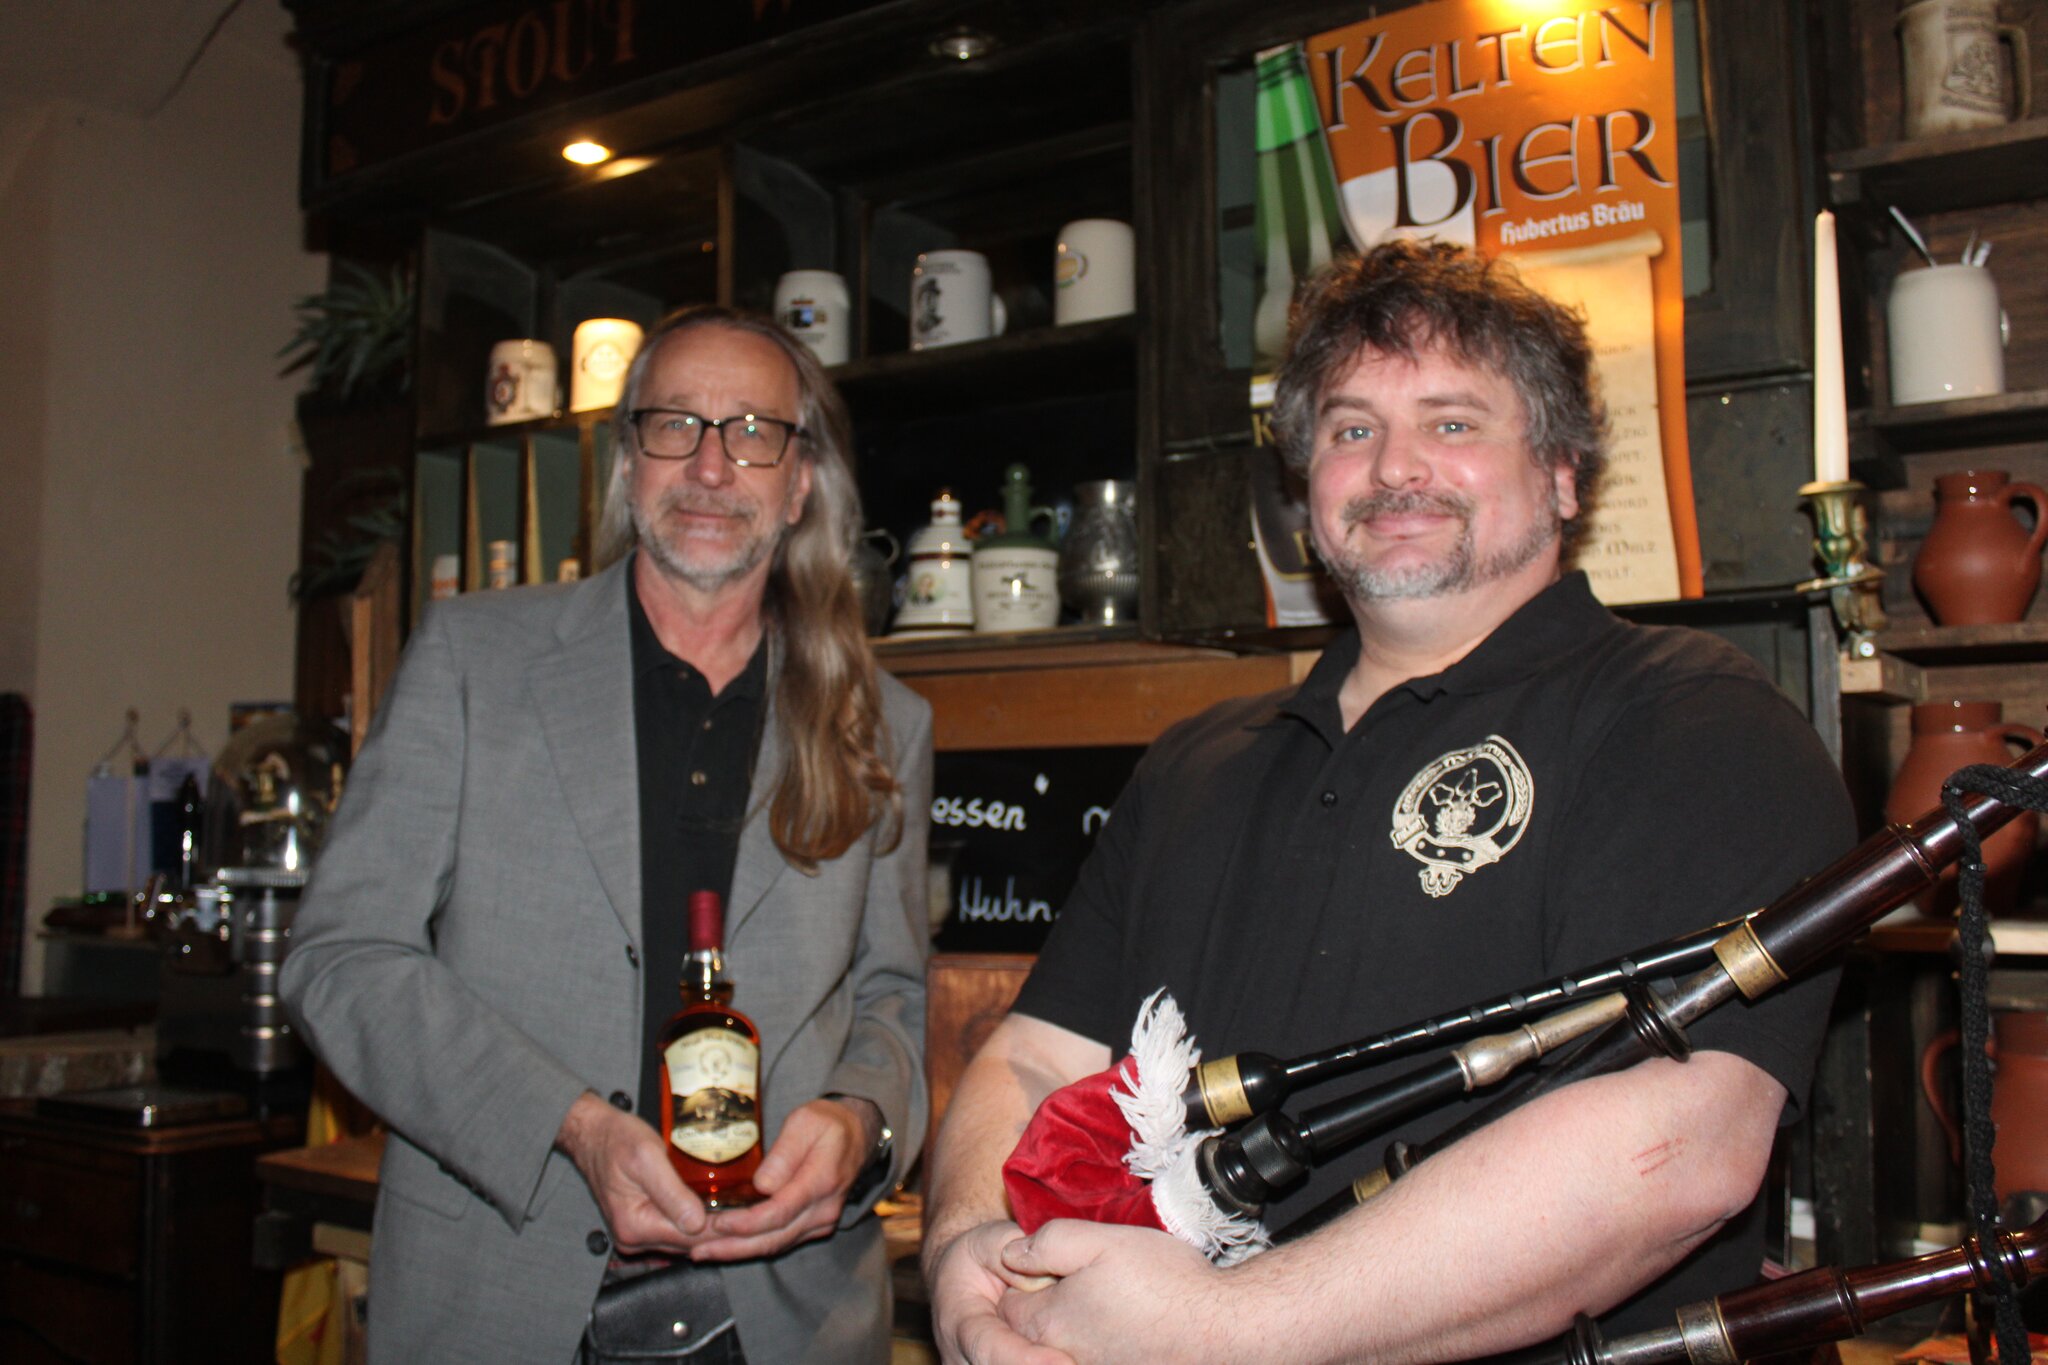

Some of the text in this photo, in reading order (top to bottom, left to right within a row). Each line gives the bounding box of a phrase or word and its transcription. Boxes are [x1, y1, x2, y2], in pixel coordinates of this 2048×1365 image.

[428, 0, 636, 125] STOUT
[1501, 201, 1645, 245] Hubertus Bräu
